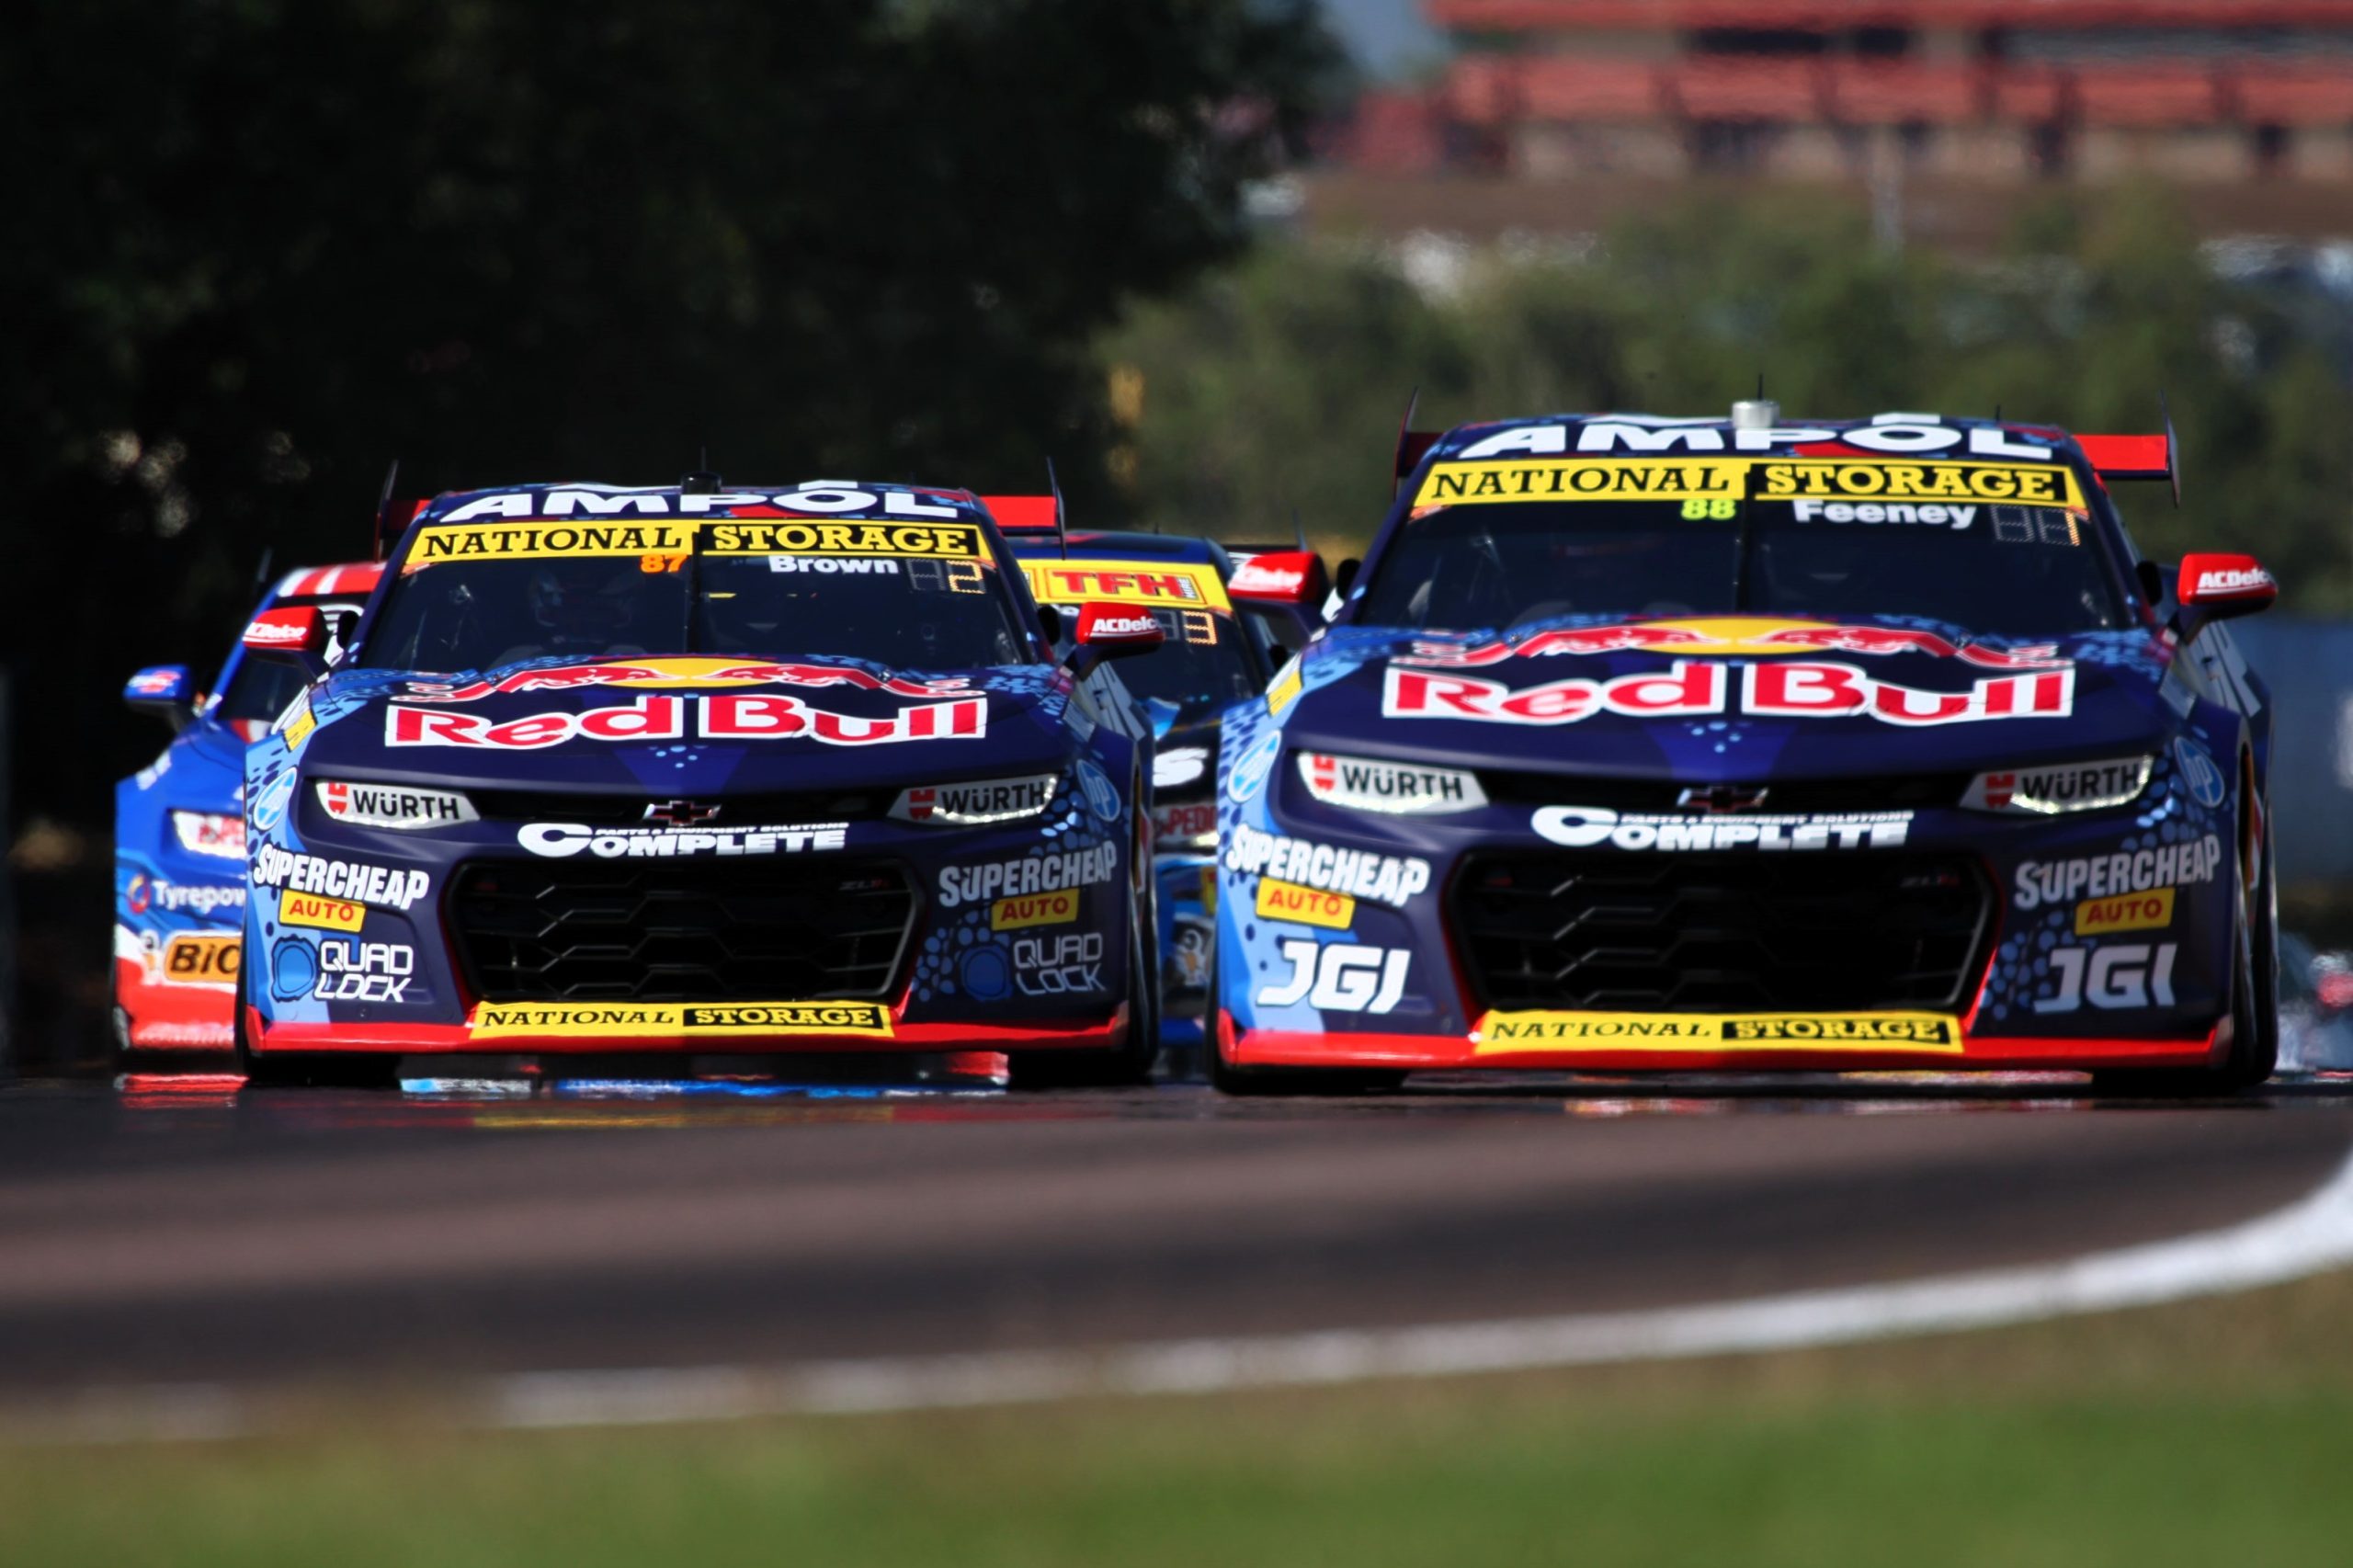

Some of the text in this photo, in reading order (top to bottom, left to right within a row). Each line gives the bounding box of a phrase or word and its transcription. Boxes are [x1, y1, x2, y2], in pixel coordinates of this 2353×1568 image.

[1431, 465, 2054, 500] NATIONAL STORAGE
[1680, 499, 1977, 528] 88 Feeney
[424, 525, 968, 557] NATIONAL STORAGE
[641, 553, 899, 574] 87 Brown
[1052, 572, 1184, 597] TFH
[1382, 661, 2075, 726] Red Bull
[385, 695, 988, 749] Red Bull
[517, 824, 846, 858] COMPLETE
[1530, 805, 1909, 850] COMPLETE
[254, 843, 429, 910] SUPERCHEAP
[938, 841, 1117, 907] SUPERCHEAP
[1226, 823, 1431, 907] SUPERCHEAP
[2015, 834, 2222, 910] SUPERCHEAP
[289, 898, 355, 923] AUTO
[1000, 896, 1069, 923] AUTO
[1267, 890, 1343, 916] AUTO
[2086, 898, 2163, 926] AUTO
[320, 940, 414, 976] QUAD
[1014, 931, 1103, 965] QUAD
[313, 974, 412, 1003] LOCK
[1015, 962, 1106, 995] LOCK
[1256, 941, 1411, 1013] JGI
[2034, 943, 2177, 1013] JGI
[483, 1008, 874, 1028] NATIONAL STORAGE
[1491, 1017, 1940, 1040] NATIONAL STORAGE
